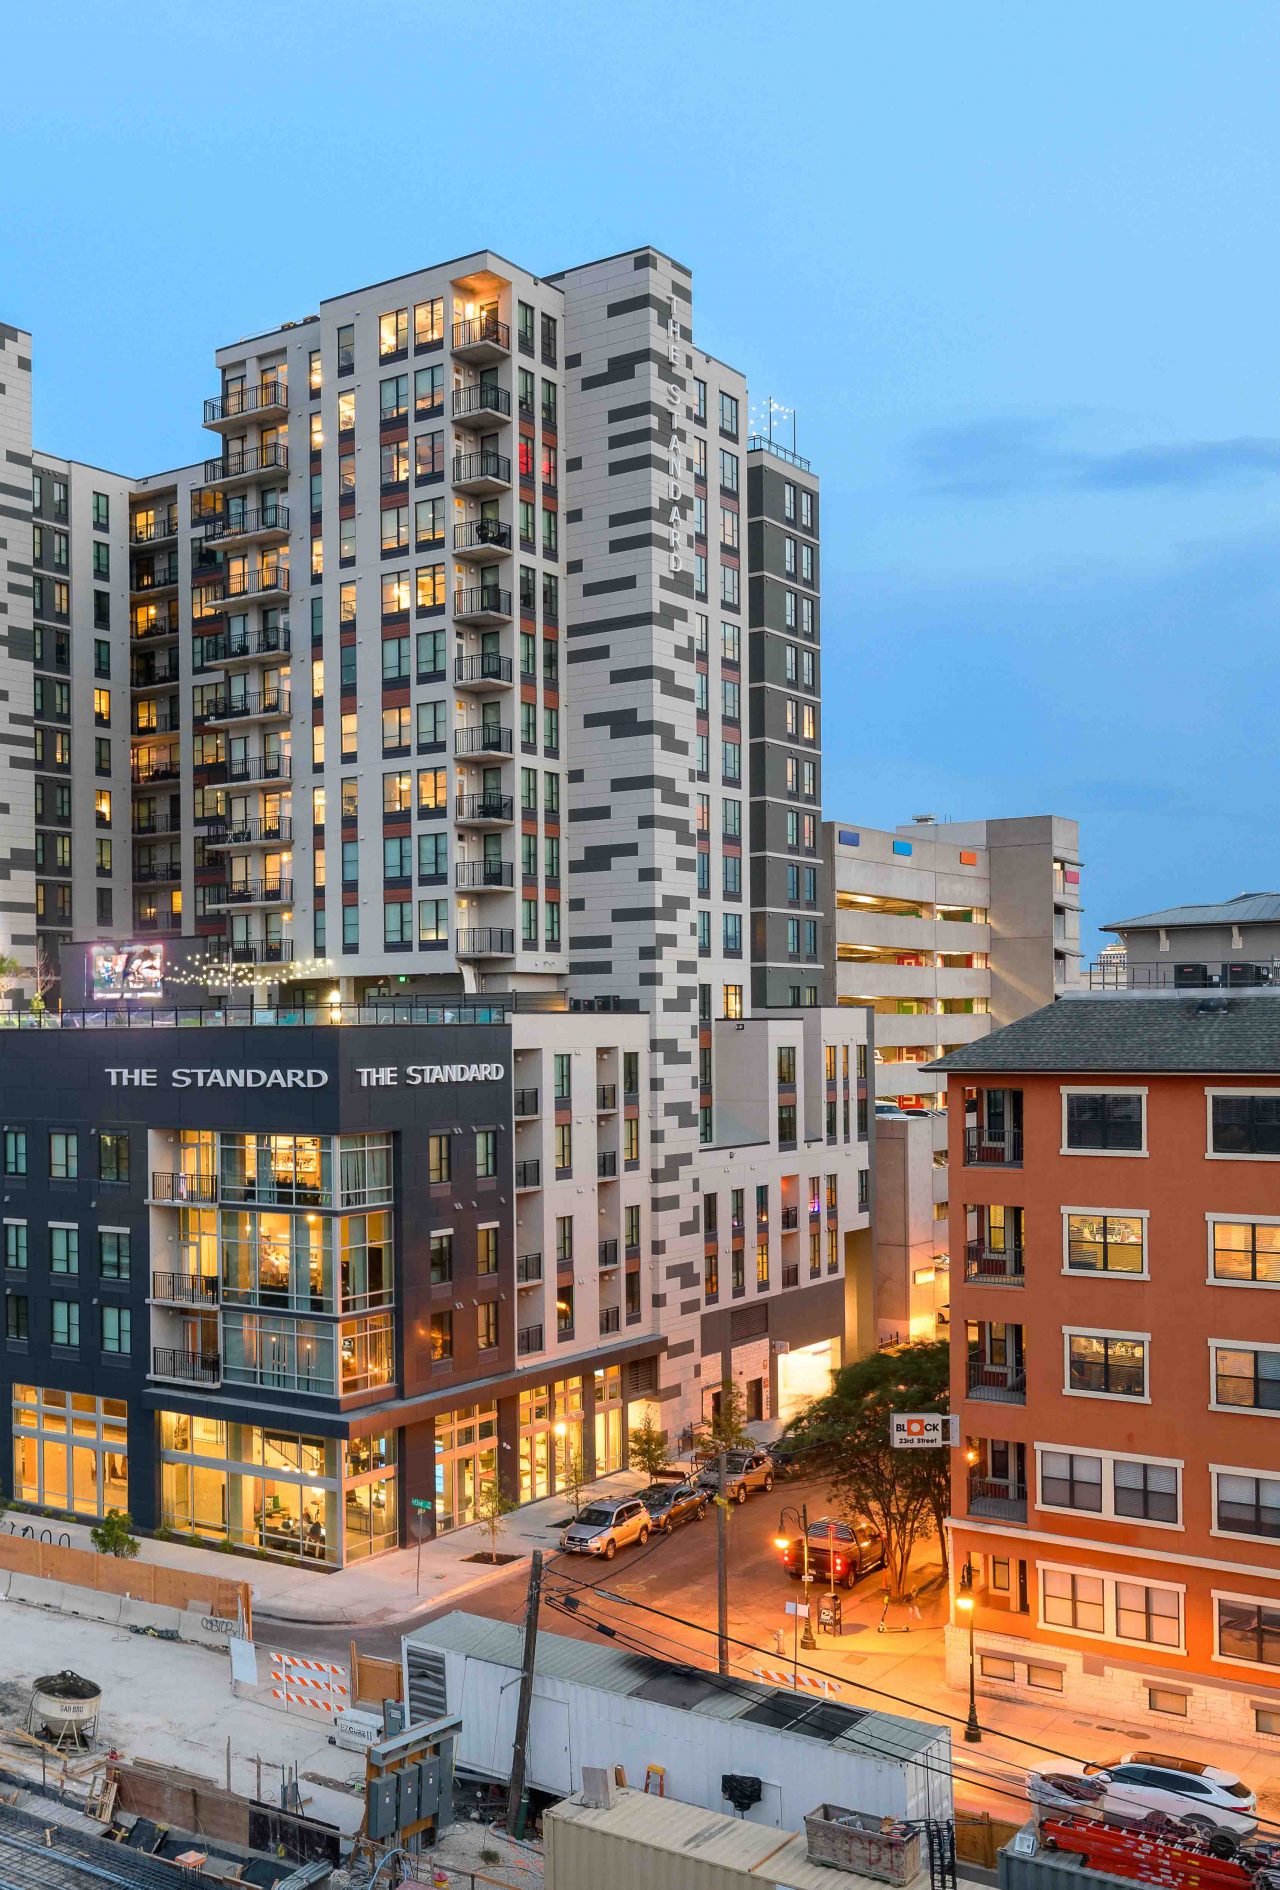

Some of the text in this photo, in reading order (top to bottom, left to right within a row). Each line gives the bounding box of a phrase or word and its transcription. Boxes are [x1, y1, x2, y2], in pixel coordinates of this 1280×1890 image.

[667, 293, 683, 573] THE STANDARD
[105, 1068, 329, 1088] THE STANDARD
[356, 1063, 505, 1087] THE STANDARD
[896, 1420, 939, 1435] BLOCK
